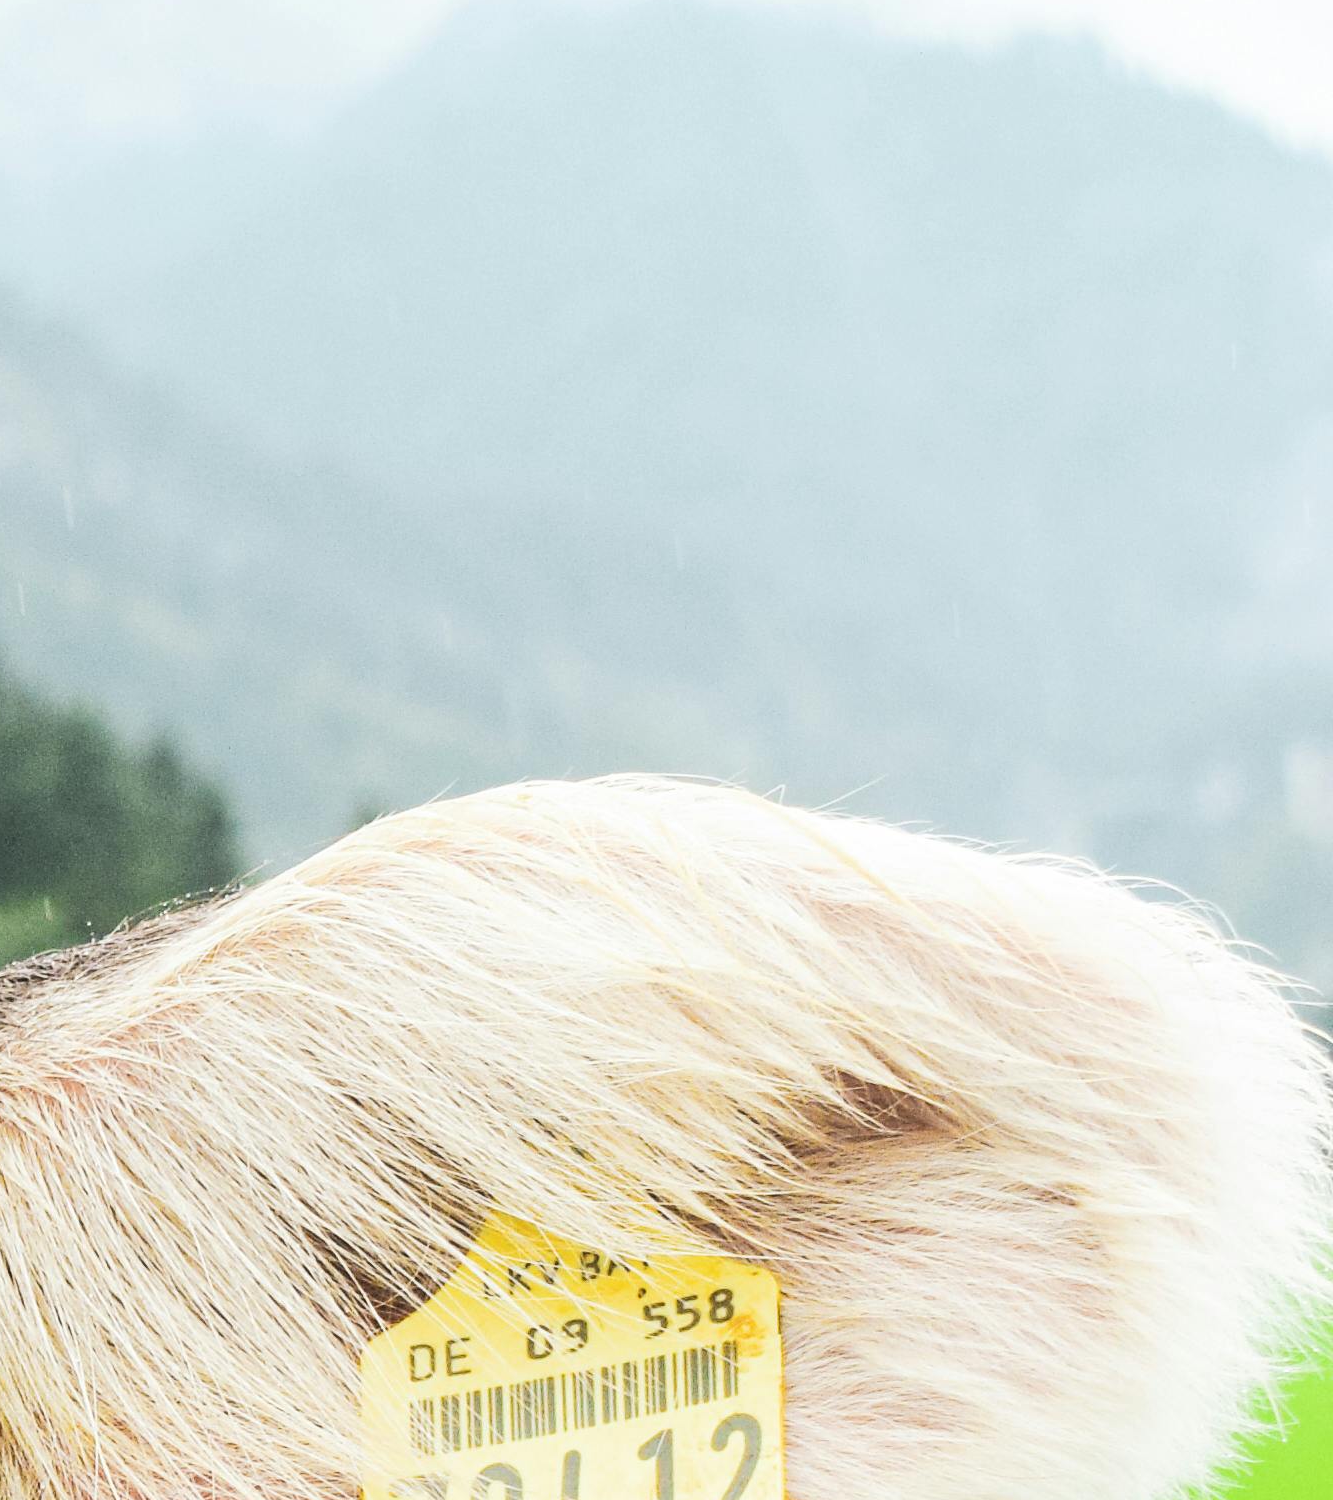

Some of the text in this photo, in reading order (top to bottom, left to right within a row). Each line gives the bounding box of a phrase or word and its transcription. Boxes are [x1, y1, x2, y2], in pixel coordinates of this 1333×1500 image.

[409, 1288, 735, 1383] DE 09 558
